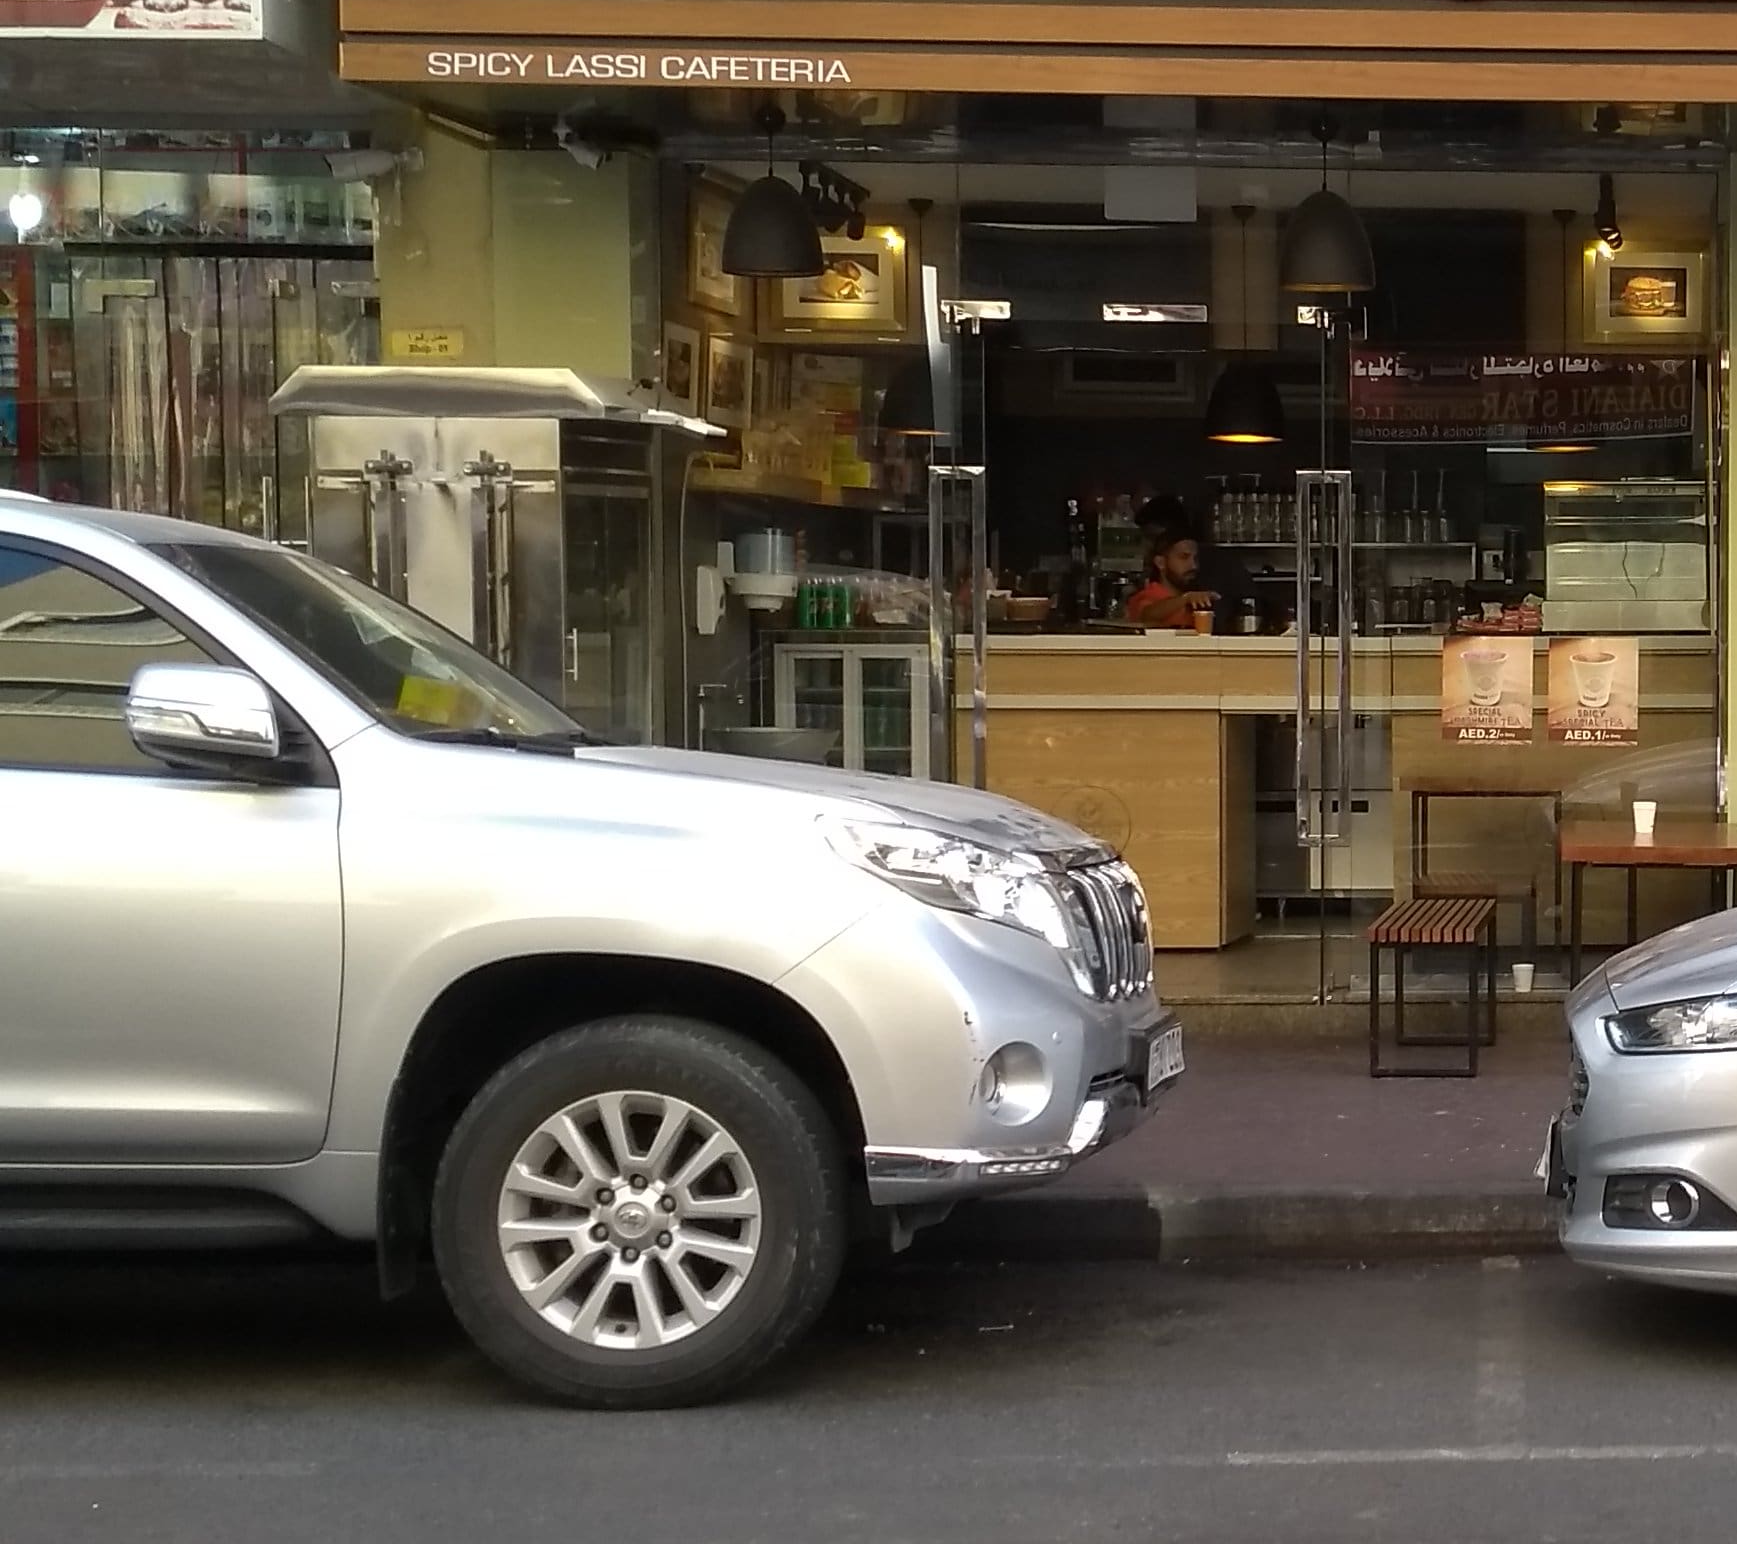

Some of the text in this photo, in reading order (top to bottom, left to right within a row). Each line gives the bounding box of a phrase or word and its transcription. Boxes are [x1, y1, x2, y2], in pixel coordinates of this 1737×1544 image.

[426, 51, 852, 84] SPICY LASSI CAFETERIA
